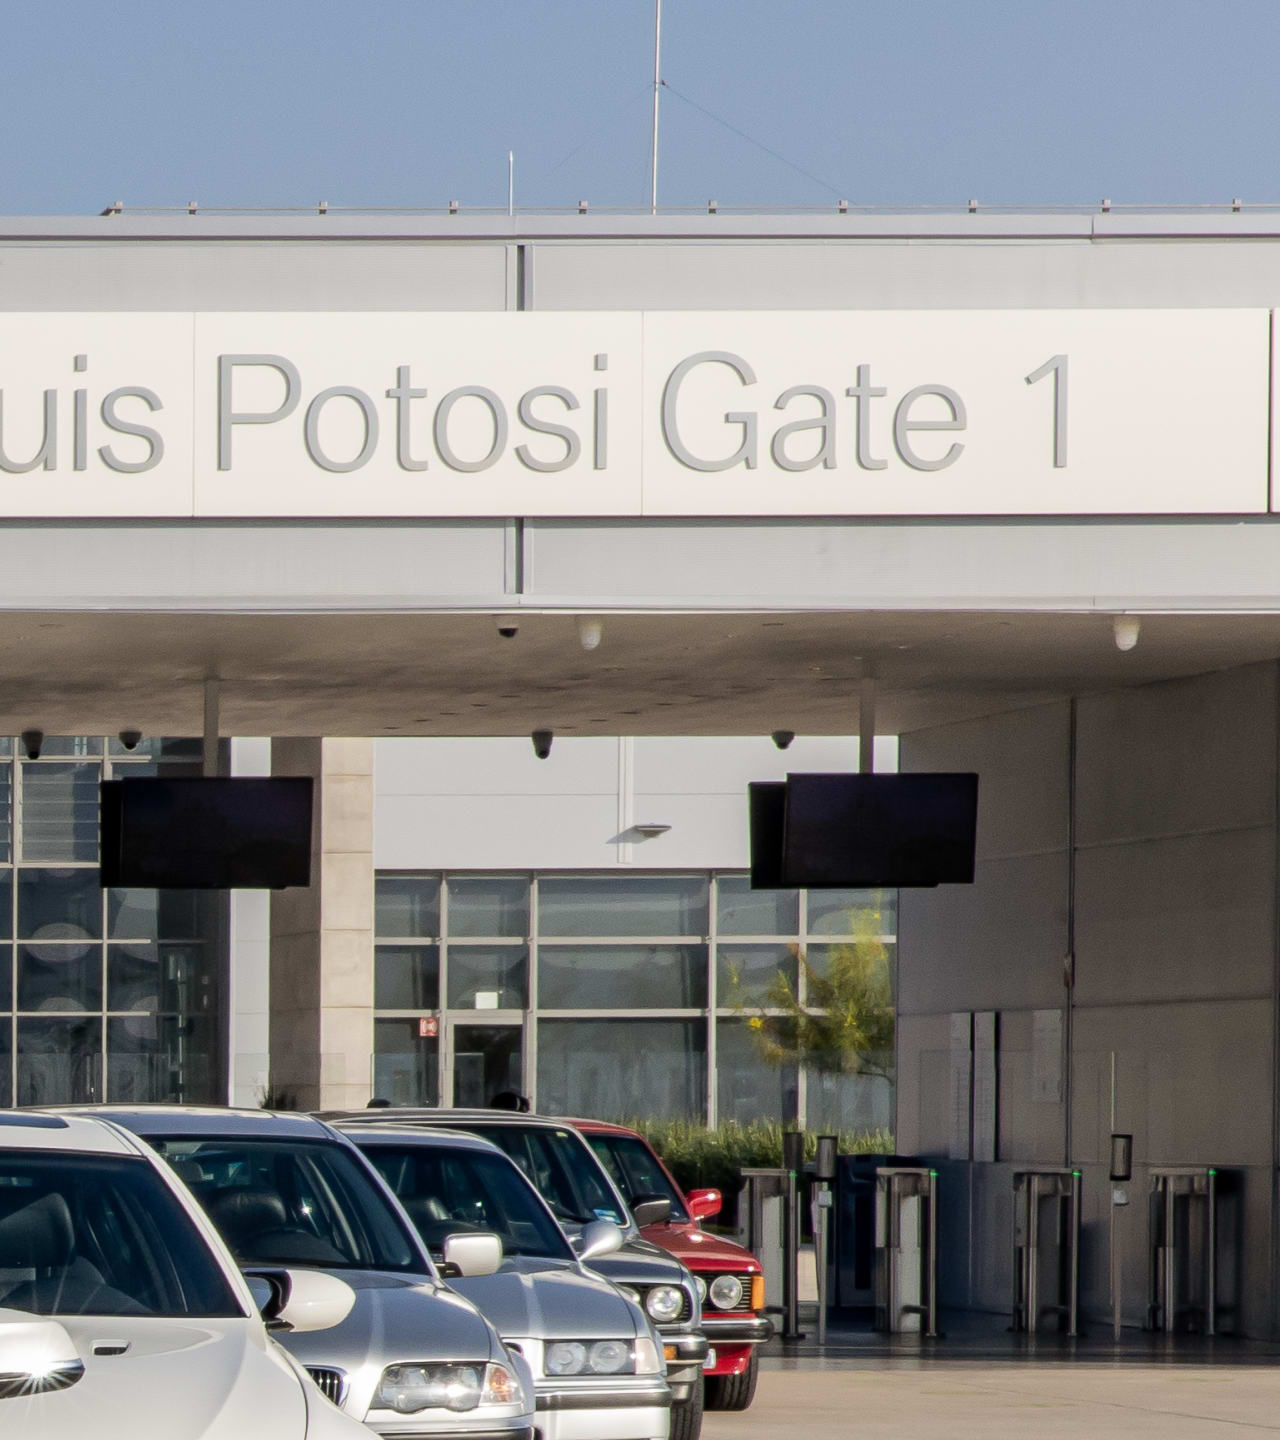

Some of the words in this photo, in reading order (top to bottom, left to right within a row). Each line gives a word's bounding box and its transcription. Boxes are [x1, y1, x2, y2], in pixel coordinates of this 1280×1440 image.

[216, 353, 608, 474] Potosi
[660, 351, 968, 473] Gate
[1024, 354, 1069, 469] 1
